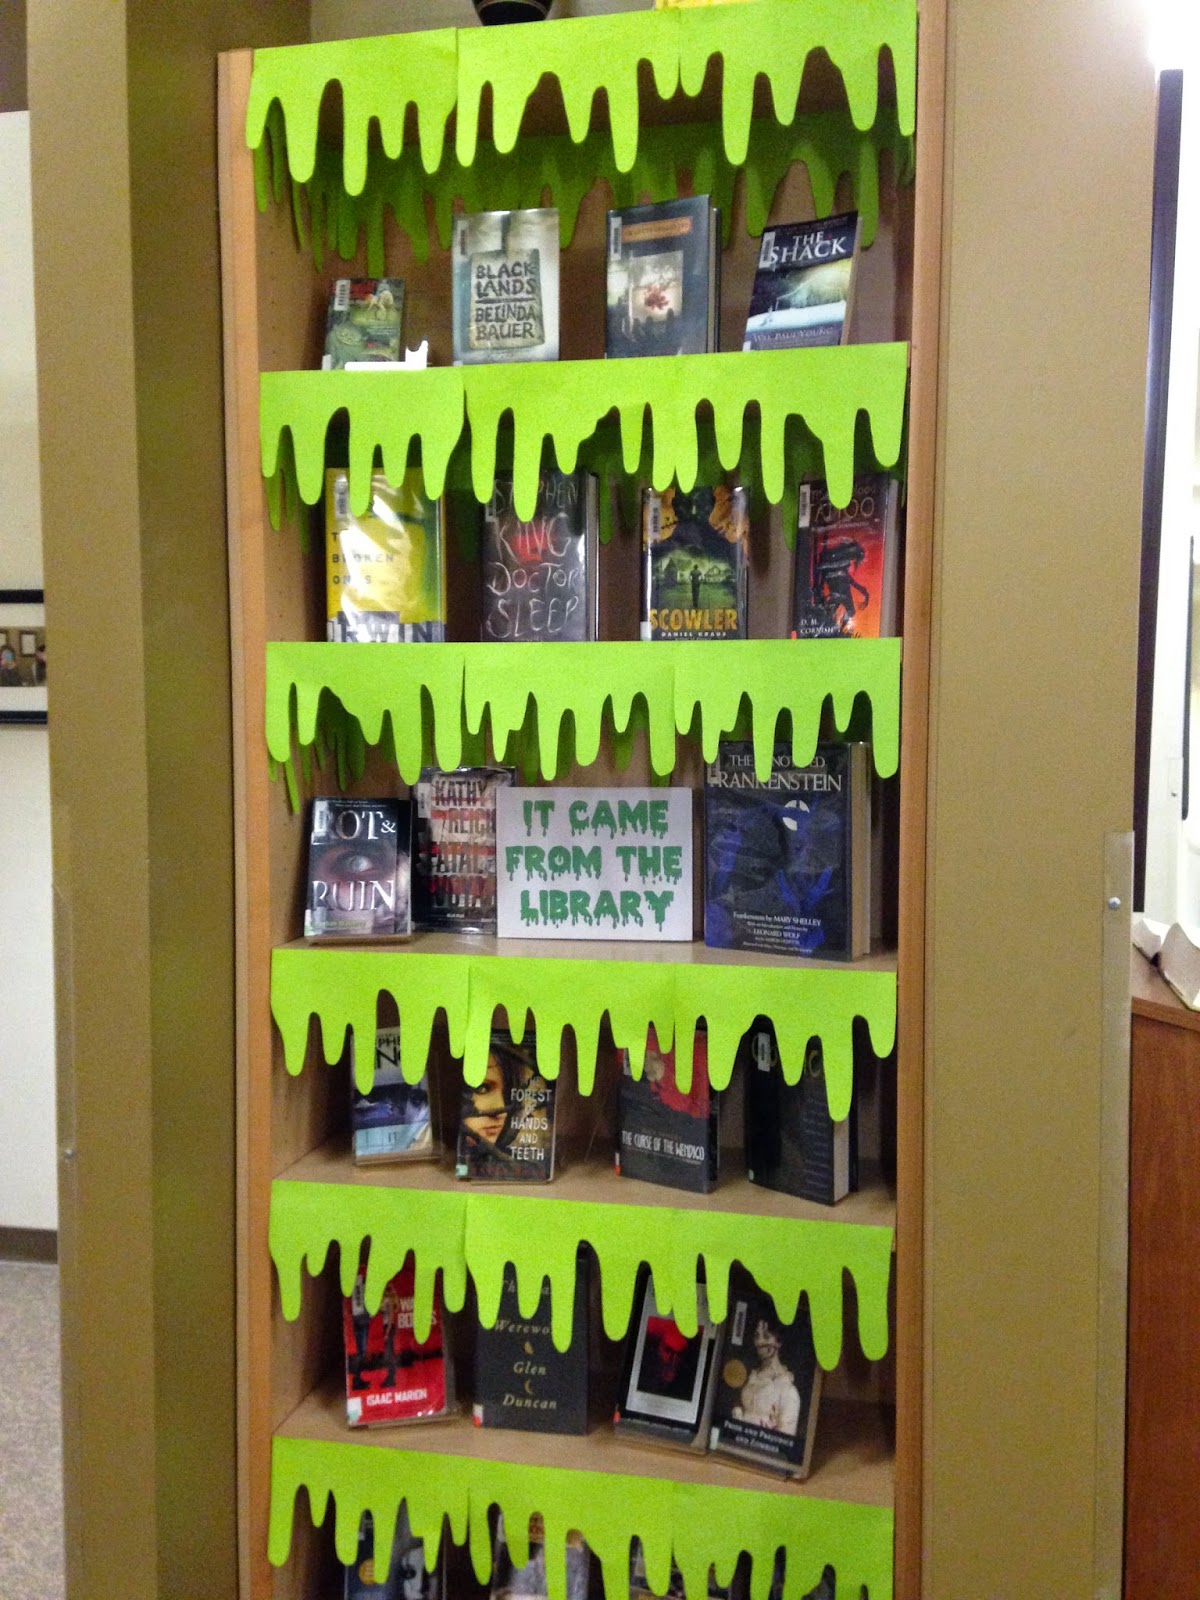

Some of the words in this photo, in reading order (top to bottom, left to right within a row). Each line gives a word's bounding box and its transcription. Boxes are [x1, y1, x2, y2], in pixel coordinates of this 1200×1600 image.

[792, 230, 824, 247] THE
[769, 236, 848, 264] SHACK
[475, 261, 536, 280] BLACK
[475, 279, 537, 298] LANDS
[475, 302, 537, 323] BELINDA
[475, 321, 535, 342] BAUER
[494, 512, 572, 564] KING
[486, 562, 579, 596] DOCTOR
[485, 596, 579, 639] SLEEP
[650, 608, 737, 631] SCOWLER
[730, 755, 754, 767] THE
[435, 780, 488, 806] KATHY
[380, 819, 397, 834] &
[522, 800, 555, 837] IT
[568, 800, 669, 839] CAME
[505, 845, 602, 882] FROM
[615, 845, 682, 885] THE
[312, 879, 395, 912] RUIN
[520, 889, 675, 932] LIBRARY
[773, 916, 792, 924] MARY
[792, 917, 822, 927] SHELLEY
[510, 1088, 553, 1103] FOREST
[510, 1117, 549, 1130] HANDS
[519, 1134, 538, 1144] AND
[621, 1130, 633, 1146] THE
[633, 1133, 652, 1150] CURSE
[653, 1136, 662, 1152] OF
[663, 1138, 675, 1155] THE
[510, 1146, 545, 1161] TEETH
[494, 1319, 550, 1335] Werewo
[513, 1361, 548, 1376] Glen
[366, 1391, 392, 1406] ISAAC
[394, 1388, 428, 1405] MARION
[502, 1393, 558, 1410] Duncan
